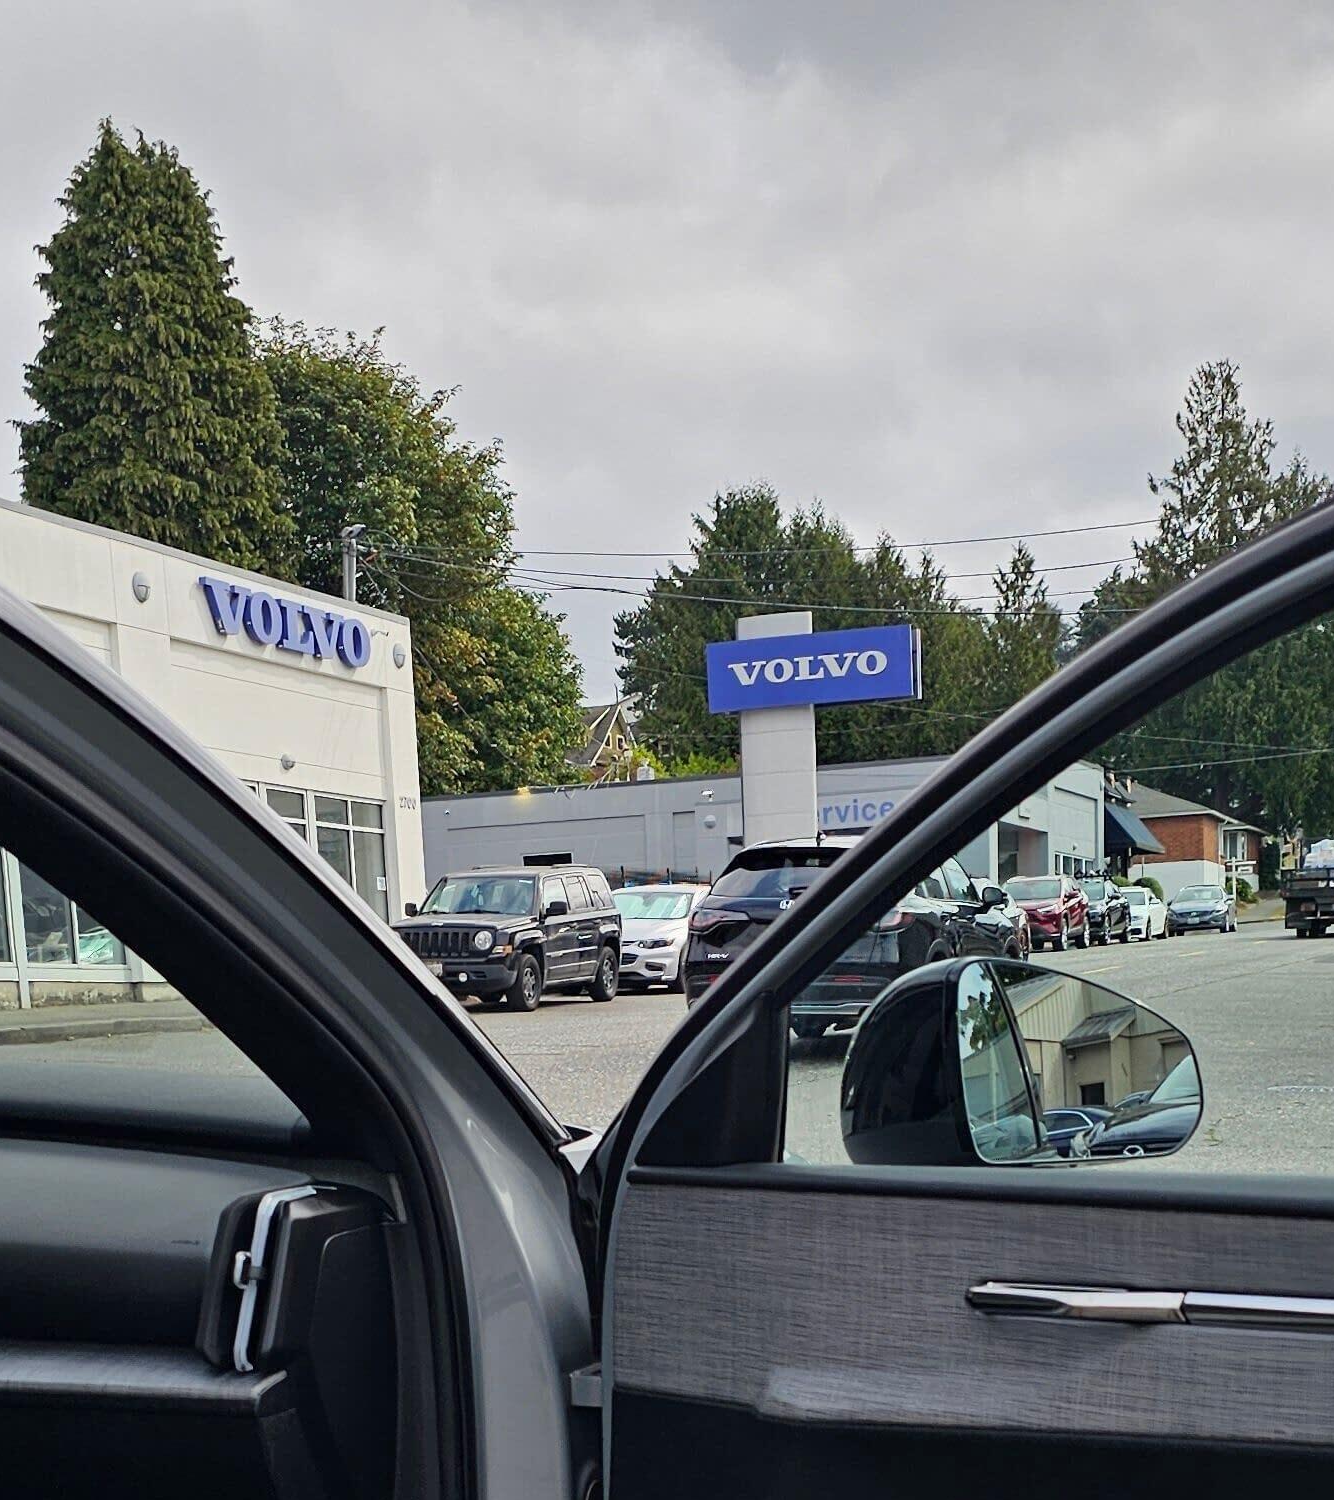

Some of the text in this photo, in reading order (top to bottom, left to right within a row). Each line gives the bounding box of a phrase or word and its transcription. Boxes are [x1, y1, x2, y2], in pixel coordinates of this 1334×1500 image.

[198, 576, 371, 668] VOLVO
[727, 650, 888, 686] VOLVO
[817, 799, 894, 825] rvice
